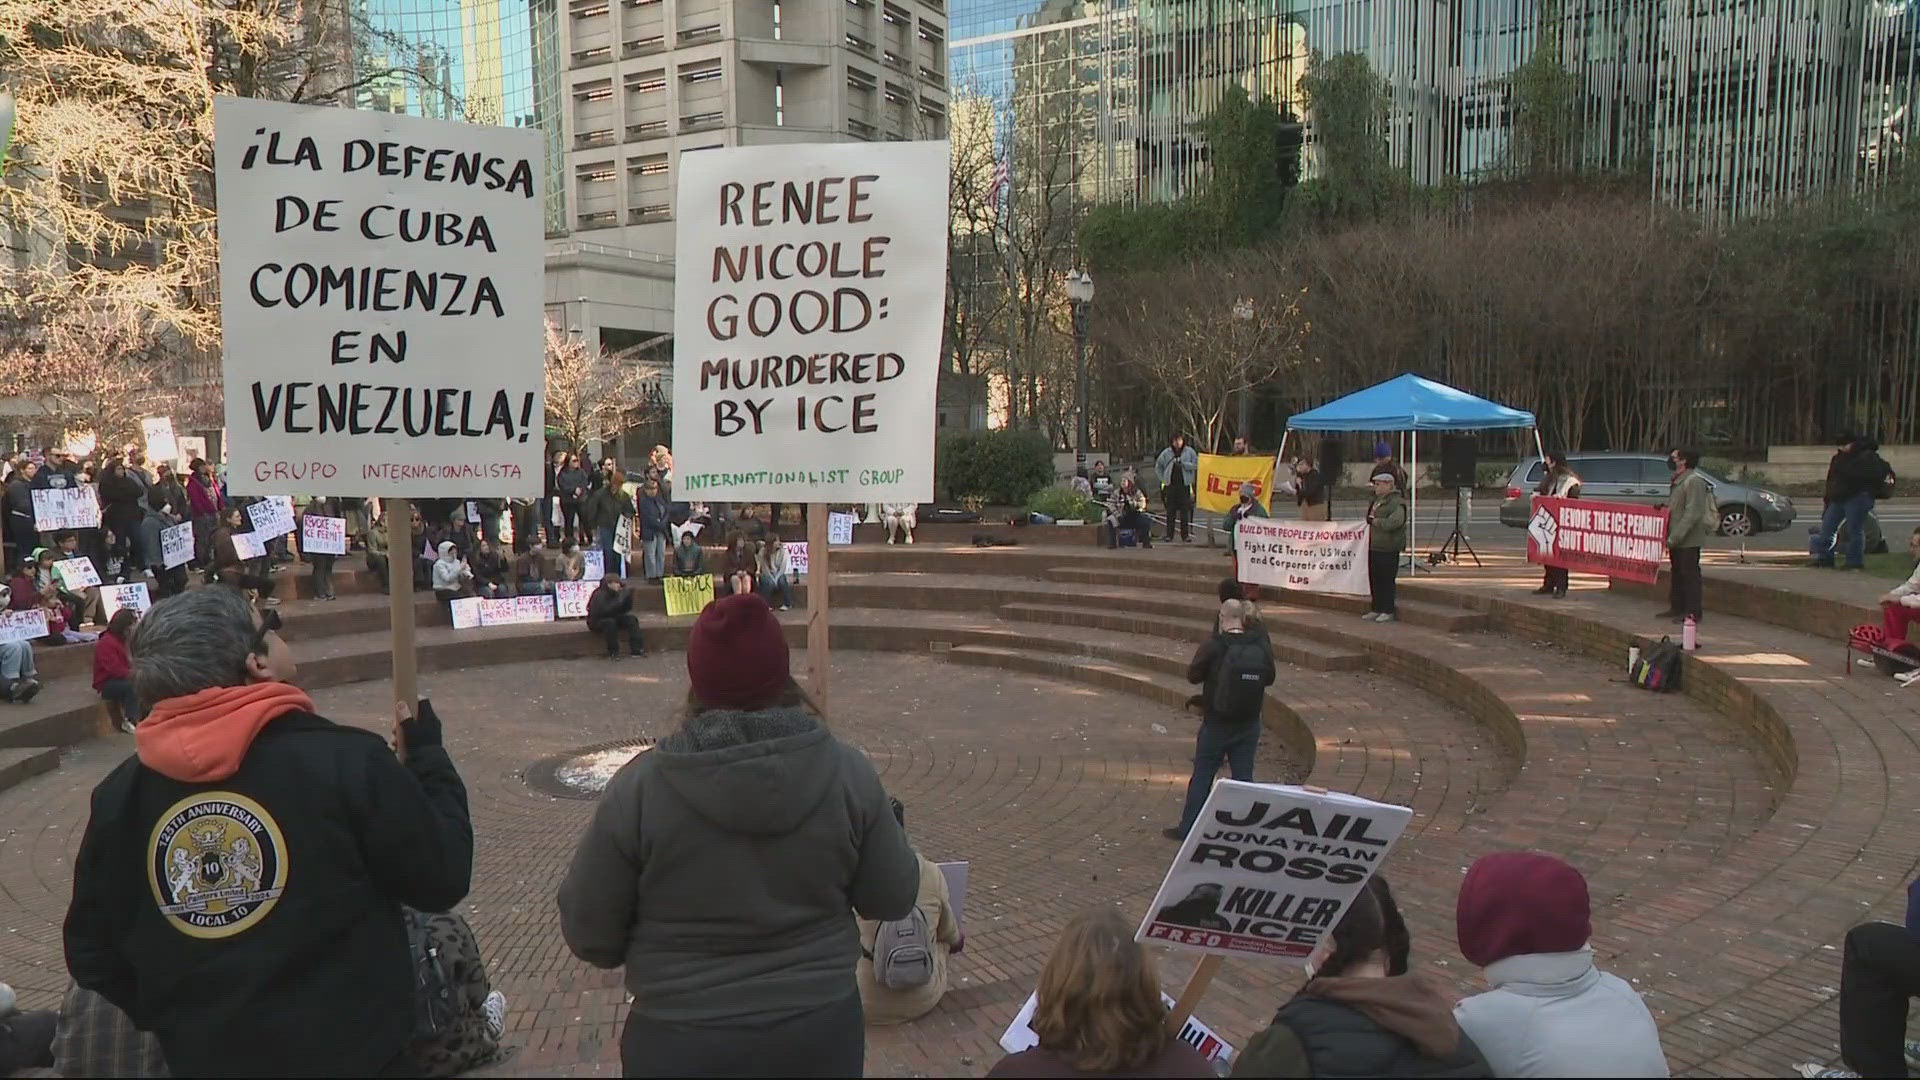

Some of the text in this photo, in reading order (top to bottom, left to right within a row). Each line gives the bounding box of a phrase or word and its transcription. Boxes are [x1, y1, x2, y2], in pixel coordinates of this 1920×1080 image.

[342, 138, 535, 199] DEFENSA
[719, 174, 880, 227] RENEE
[275, 195, 497, 253] DE CUBA
[712, 236, 892, 283] NICOLE
[249, 262, 506, 318] COMIENZA
[706, 286, 889, 341] GOOD:
[331, 329, 407, 366] EN
[700, 352, 906, 391] MURDERED
[251, 380, 535, 444] VENEZUELA!
[714, 392, 878, 437] BY ICE
[254, 460, 523, 481] GRUPO INTERNACIONALISTA
[685, 467, 904, 490] INTERNATIONALIST GROUP
[317, 530, 343, 542] PERMIT
[1239, 523, 1263, 535] BUILD
[1263, 525, 1277, 537] THE
[1278, 528, 1314, 541] PEOPLE'S
[1559, 506, 1665, 539] REVOKE THE ICE PERMIT!
[1244, 541, 1266, 554] Fight
[1268, 542, 1283, 554] ICE
[1319, 547, 1332, 557] US
[1558, 528, 1583, 552] SHUT
[1583, 531, 1612, 555] DOWN
[1250, 556, 1352, 571] and Corporate Greed!
[558, 581, 588, 592] REVOKE
[563, 601, 582, 614] ICE
[159, 803, 264, 848] 125TH ANNIVERSARY
[1214, 801, 1389, 847] JAIL
[1202, 829, 1378, 862] JONATHAN
[203, 861, 220, 876] 10
[1189, 843, 1368, 885] ROSS
[187, 888, 245, 902] Painters United
[1222, 886, 1343, 929] KILLER
[189, 905, 249, 927] LOCAL 10
[1231, 917, 1324, 945] ICE
